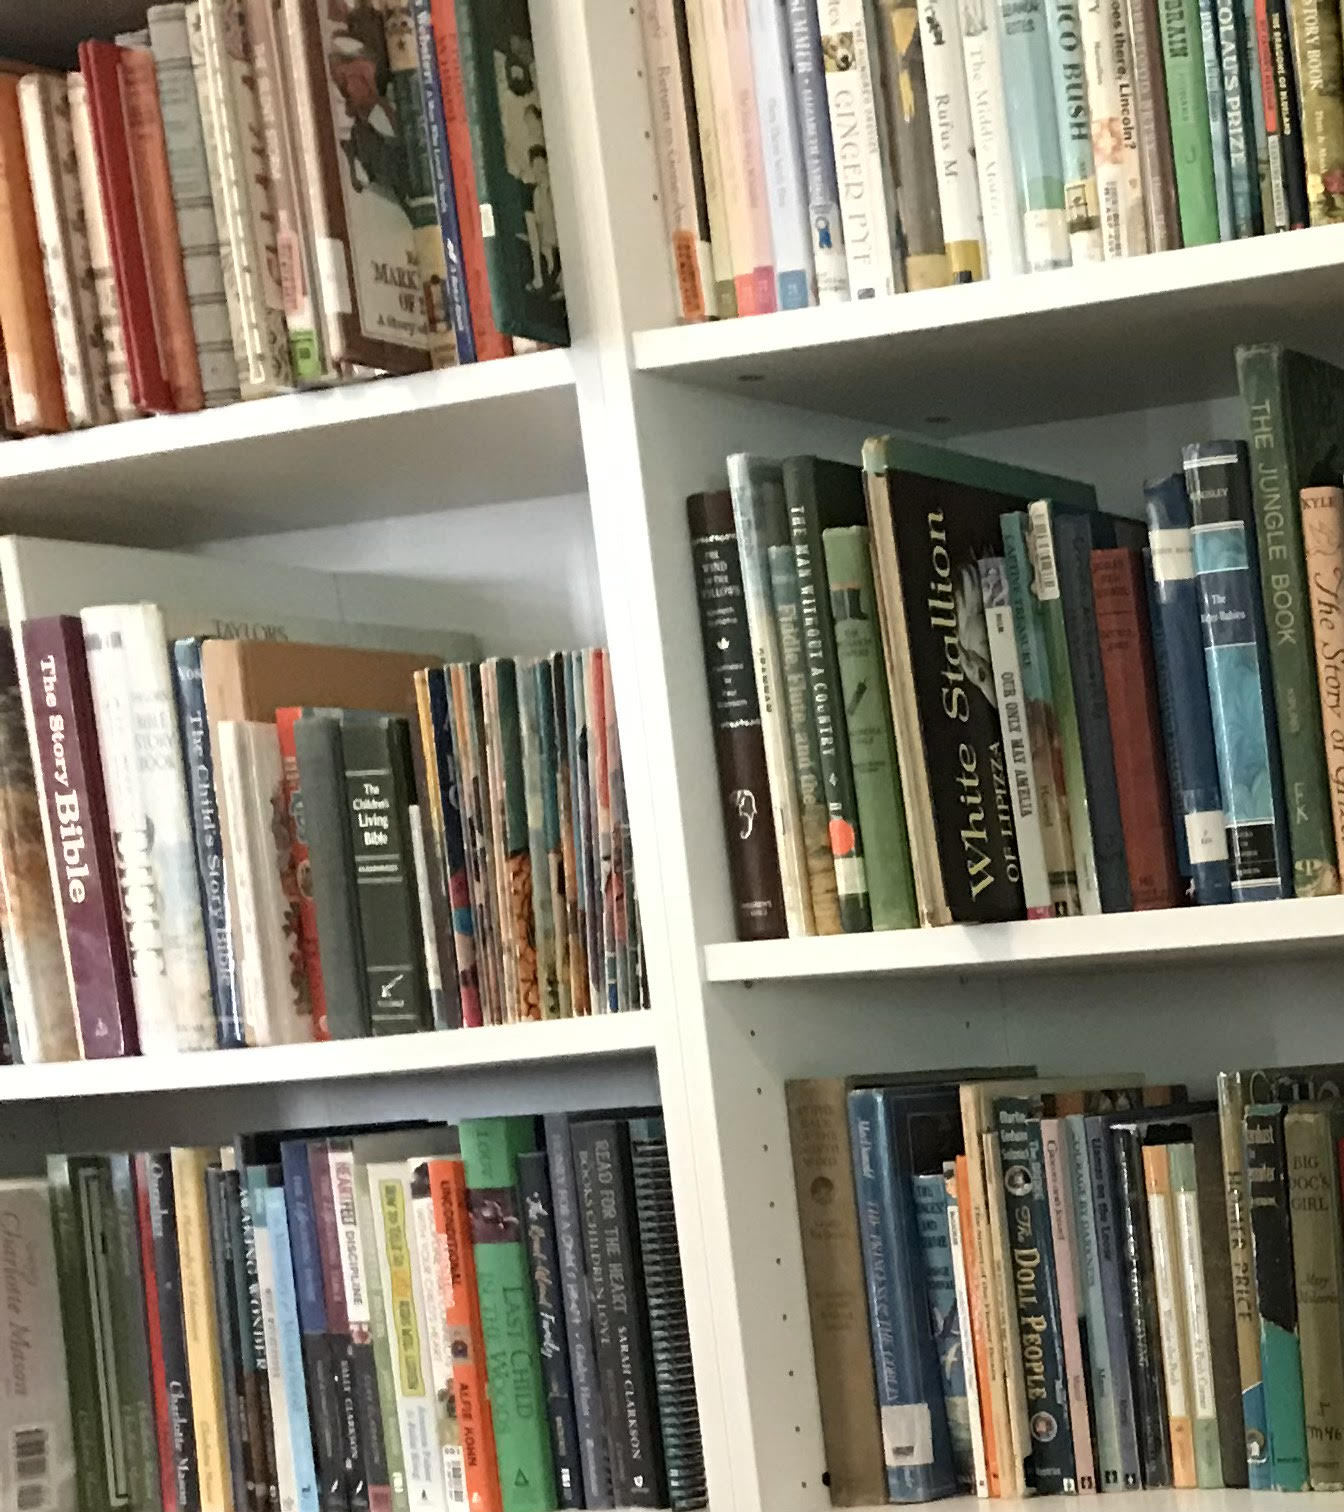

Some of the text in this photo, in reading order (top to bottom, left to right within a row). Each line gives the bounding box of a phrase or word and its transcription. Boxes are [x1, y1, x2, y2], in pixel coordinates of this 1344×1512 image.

[1062, 64, 1087, 142] BUSH
[1250, 402, 1297, 645] THE JUNGLE BOOK
[1314, 565, 1344, 628] The
[41, 655, 86, 903] The Story Bible
[930, 508, 994, 898] White Stallion
[1014, 1247, 1047, 1399] DOLL PEOPLE
[462, 1428, 477, 1467] KOHN
